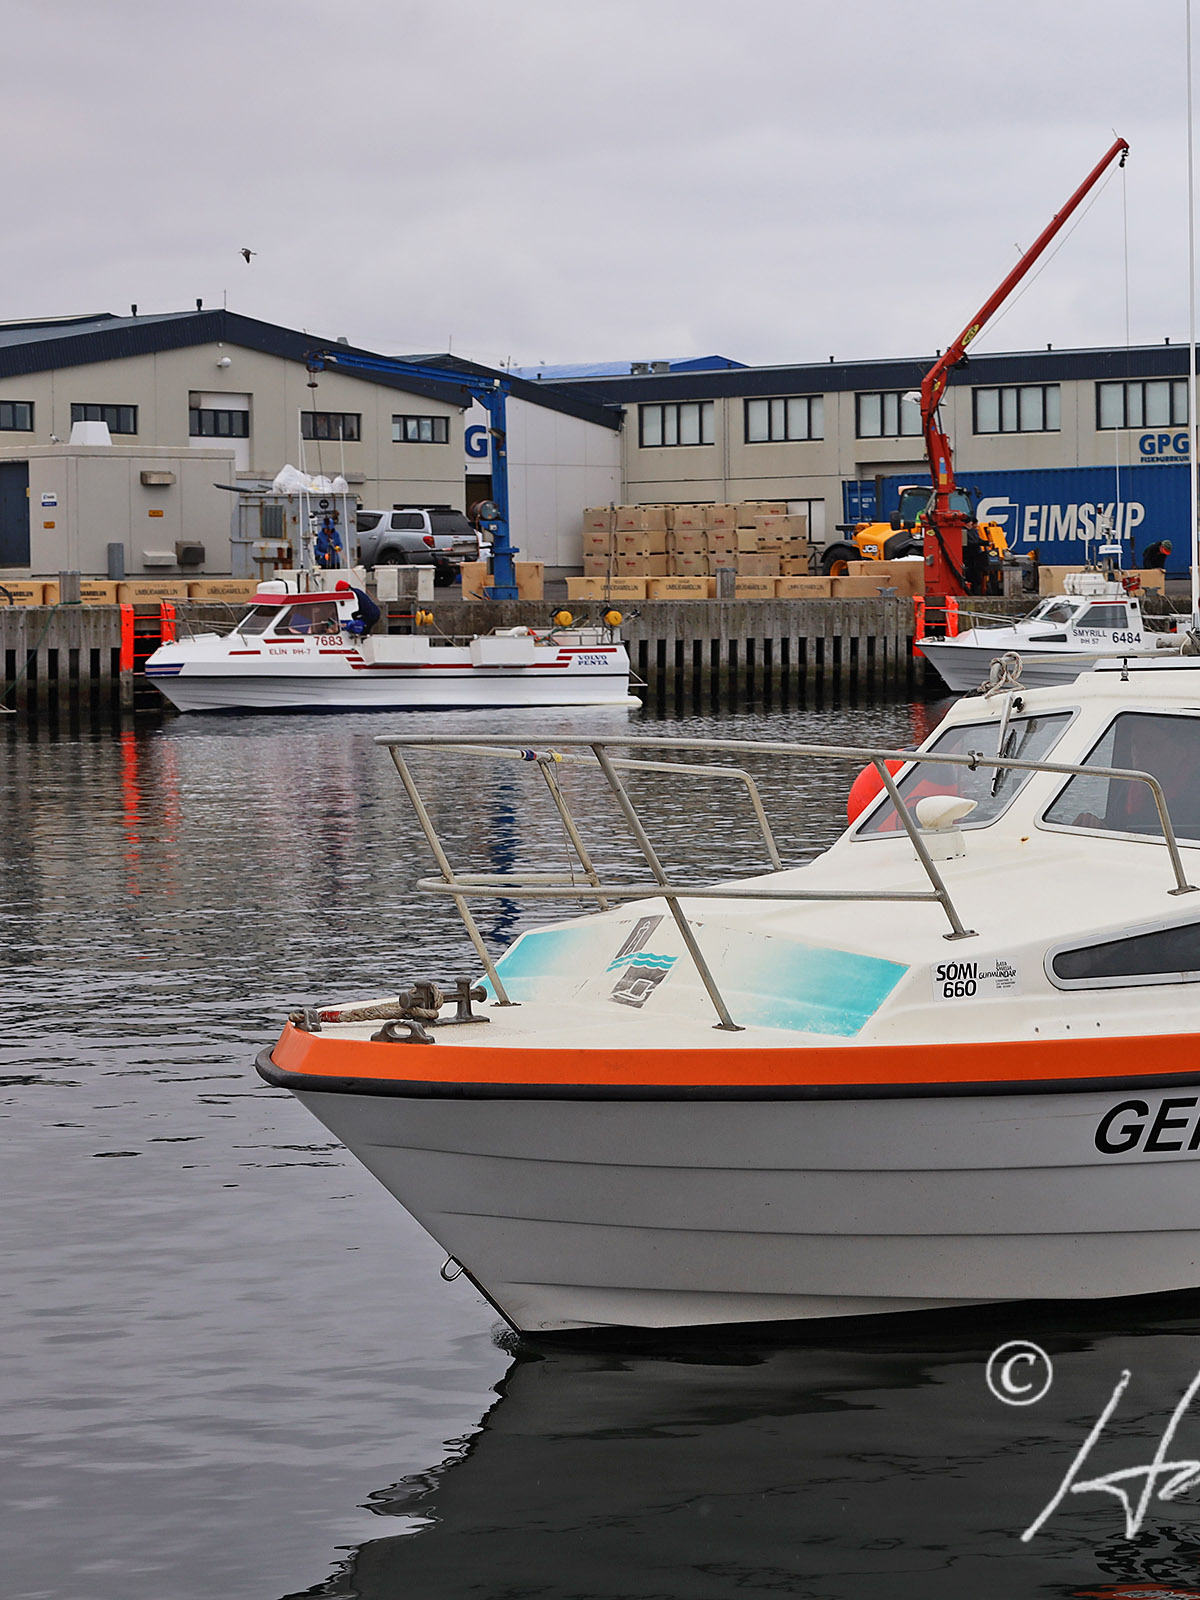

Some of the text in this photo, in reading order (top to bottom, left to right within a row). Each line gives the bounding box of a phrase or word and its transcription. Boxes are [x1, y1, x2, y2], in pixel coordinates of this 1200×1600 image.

[1139, 433, 1189, 455] GPG
[1023, 502, 1146, 542] EIMSKIP
[862, 545, 878, 553] JCB
[313, 635, 343, 646] 7683
[1072, 629, 1108, 638] SMYRILL
[1112, 631, 1141, 644] 6484
[936, 962, 977, 981] SÓMI
[943, 980, 976, 998] 660
